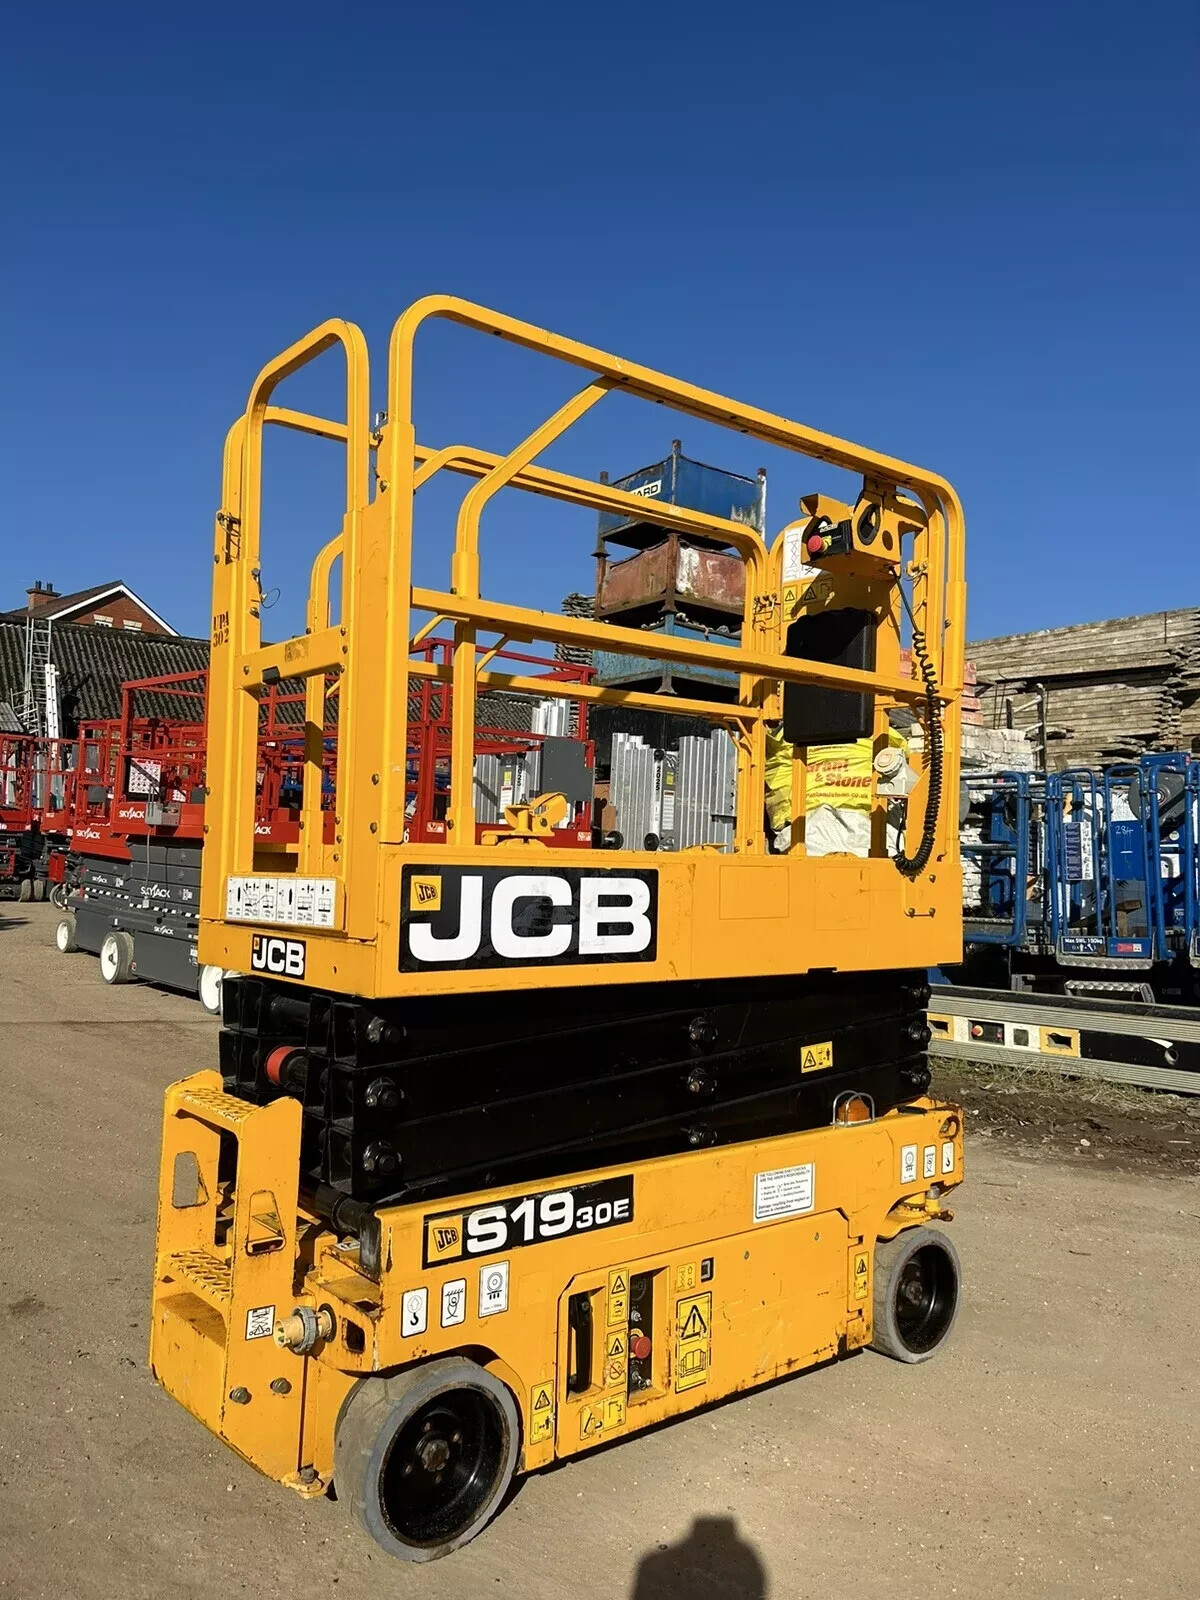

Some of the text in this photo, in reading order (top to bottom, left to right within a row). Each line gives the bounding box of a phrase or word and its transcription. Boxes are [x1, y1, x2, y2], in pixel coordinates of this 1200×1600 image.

[633, 485, 659, 497] ARD
[213, 628, 229, 647] 302
[824, 773, 872, 788] Stone
[119, 807, 145, 819] SKYJACK
[76, 828, 101, 839] SKYJACK
[418, 884, 438, 901] JCB
[408, 875, 652, 962] JCB
[252, 938, 305, 976] JCB
[435, 1229, 459, 1249] JCB
